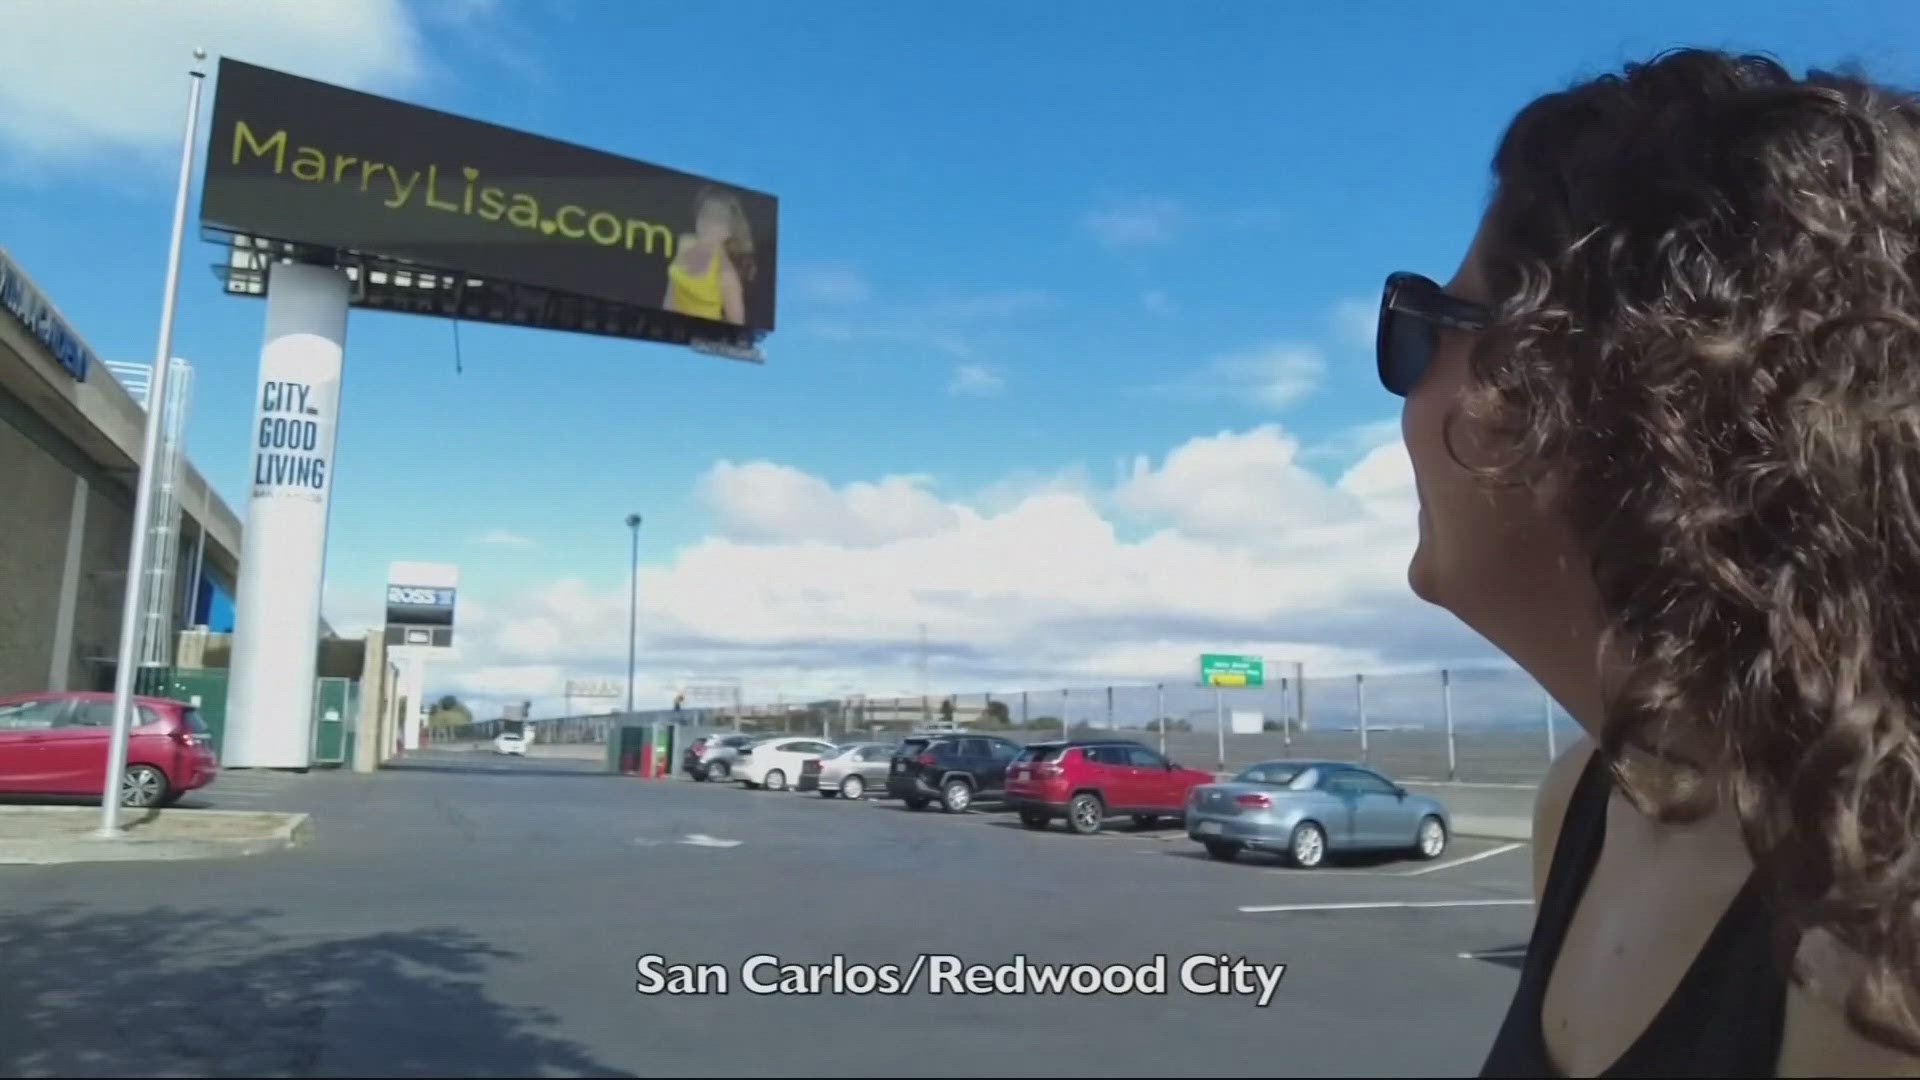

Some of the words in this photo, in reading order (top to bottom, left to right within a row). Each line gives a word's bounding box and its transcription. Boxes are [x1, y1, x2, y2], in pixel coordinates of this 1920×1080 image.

[232, 121, 674, 257] MarryLisa.com
[262, 381, 310, 414] CITY
[259, 417, 317, 451] GOOD
[255, 453, 325, 489] LIVING
[388, 586, 436, 605] ROSS
